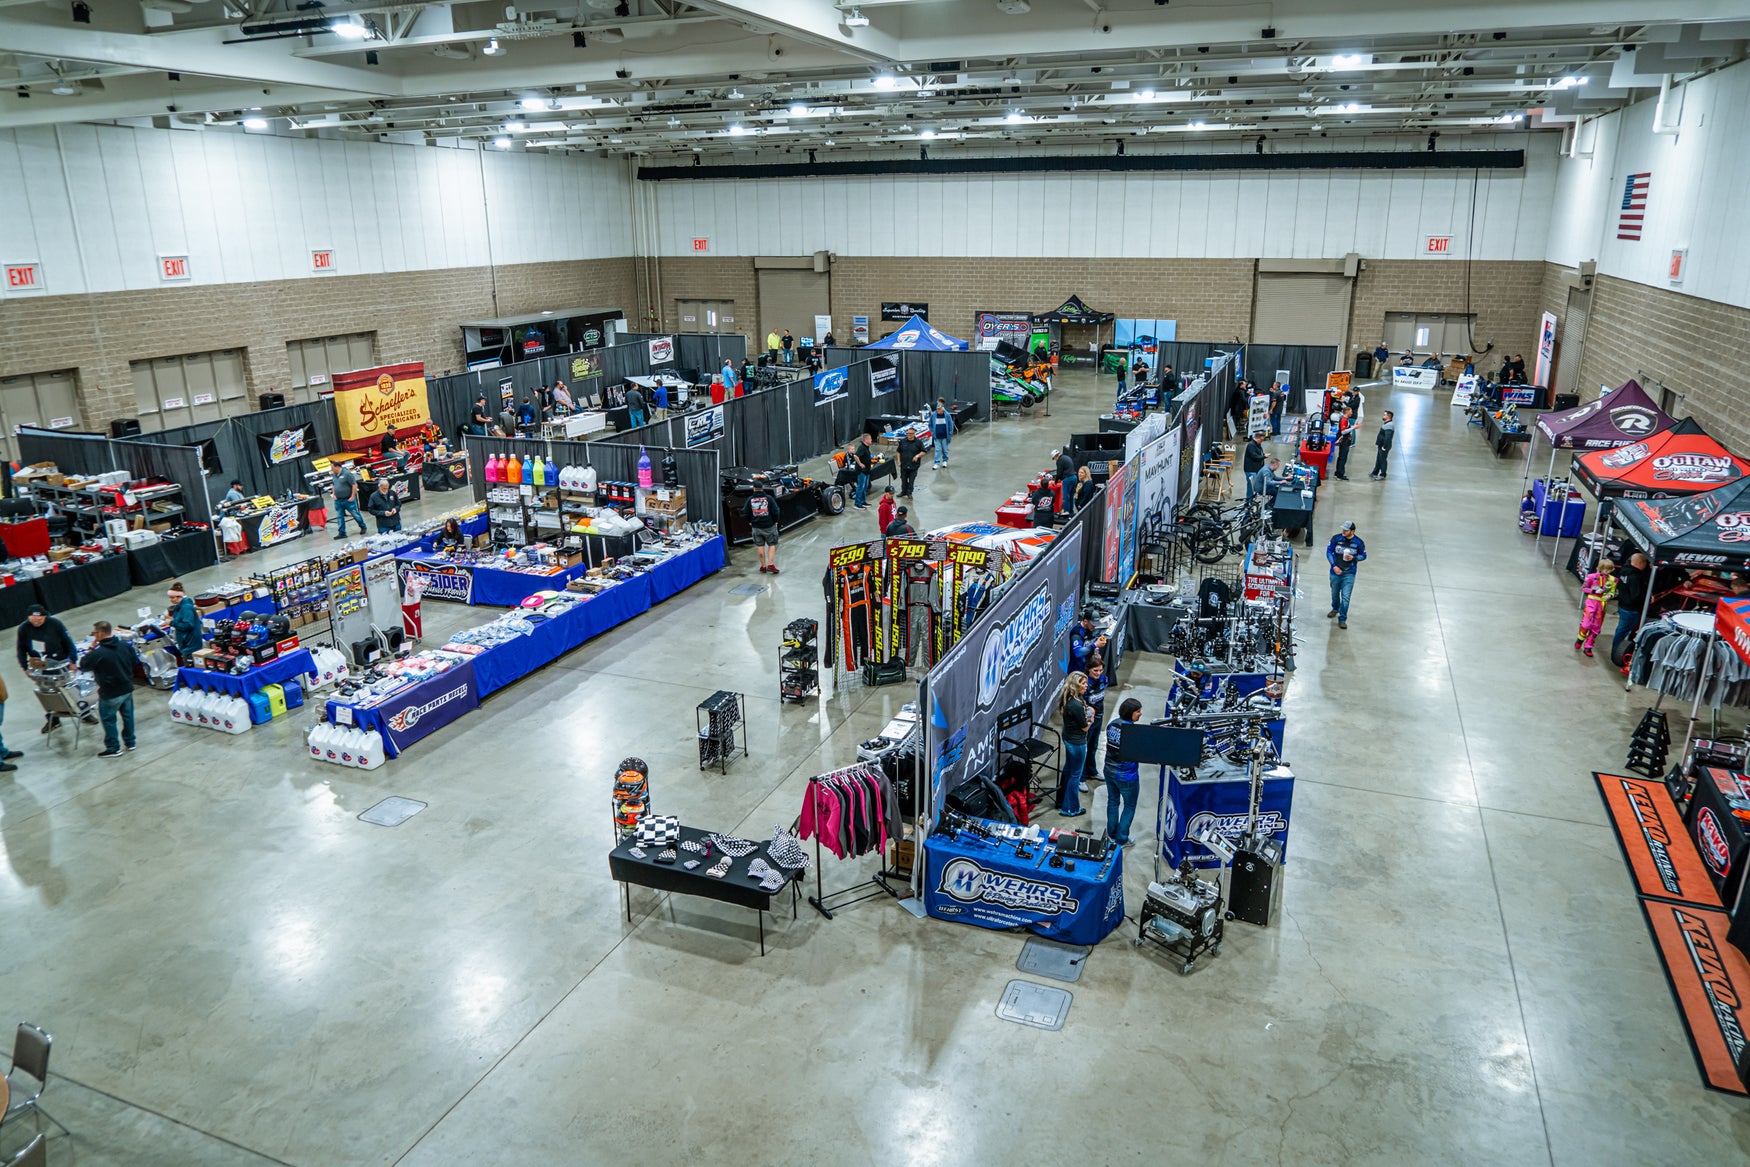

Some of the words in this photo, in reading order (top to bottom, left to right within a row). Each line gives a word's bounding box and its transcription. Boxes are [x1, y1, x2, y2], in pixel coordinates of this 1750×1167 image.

[694, 239, 707, 251] EXIT
[1428, 237, 1448, 252] EXIT
[163, 259, 185, 276] EXIT
[314, 253, 331, 268] EXIT
[7, 267, 34, 286] EXIT
[360, 388, 416, 427] Schaeffer's
[380, 408, 417, 421] SPECIALIZED
[384, 413, 421, 426] LUBRICANTS
[1585, 439, 1611, 448] RACE
[1144, 454, 1174, 480] MAVHUNT
[833, 547, 866, 566] $599
[890, 545, 926, 558] $799
[949, 550, 986, 565] $1099
[1675, 553, 1728, 563] KEVKO
[1003, 585, 1048, 647] WEHRS
[1000, 601, 1051, 663] MACHINE
[1028, 652, 1053, 690] MADE
[411, 707, 427, 720] RACE
[428, 696, 447, 711] PARTS
[986, 873, 1067, 900] WEHRS
[979, 884, 1076, 909] MACHINE
[973, 907, 1033, 924] www.wehrsmachine.com
